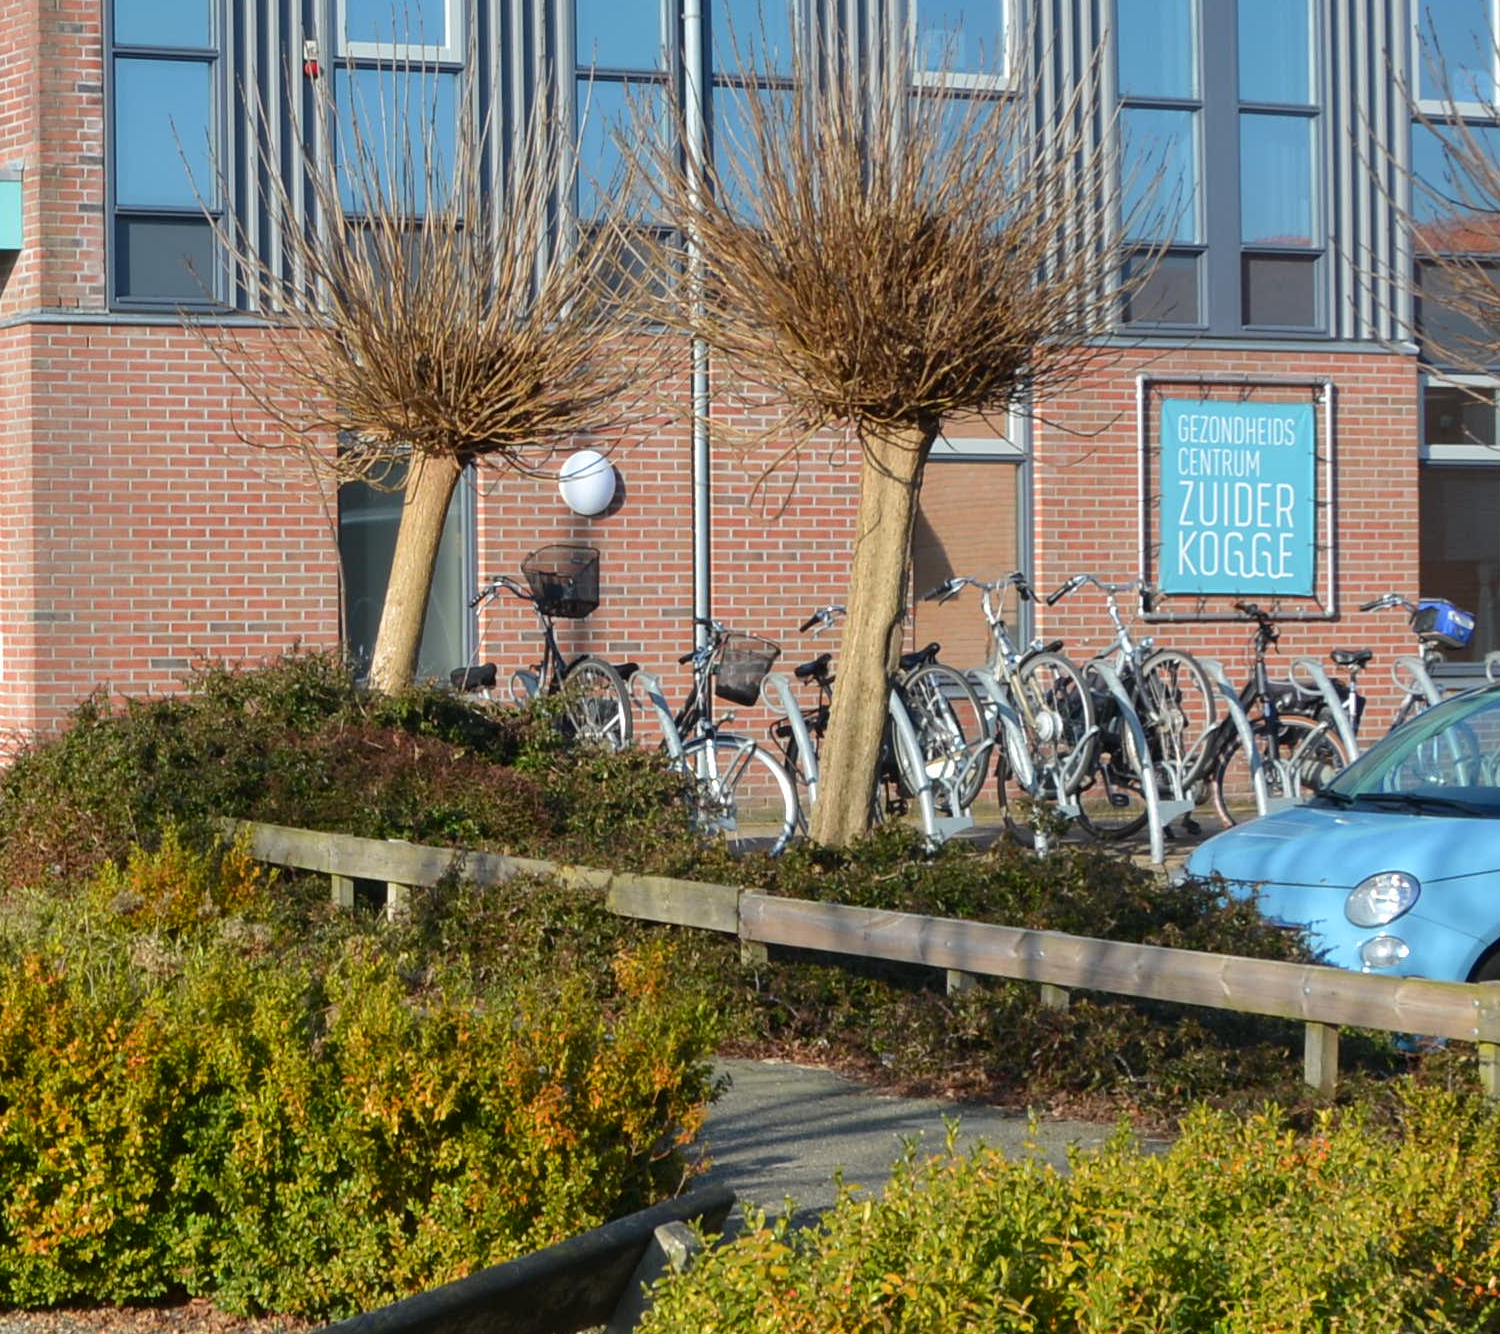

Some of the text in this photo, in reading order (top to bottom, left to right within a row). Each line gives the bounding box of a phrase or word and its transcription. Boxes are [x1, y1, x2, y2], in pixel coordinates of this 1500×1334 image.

[1178, 414, 1296, 446] GEZONDHEIDS
[1178, 447, 1260, 477] CENTRUM
[1178, 481, 1295, 528] ZUIDER
[1178, 531, 1294, 579] KOGGE
